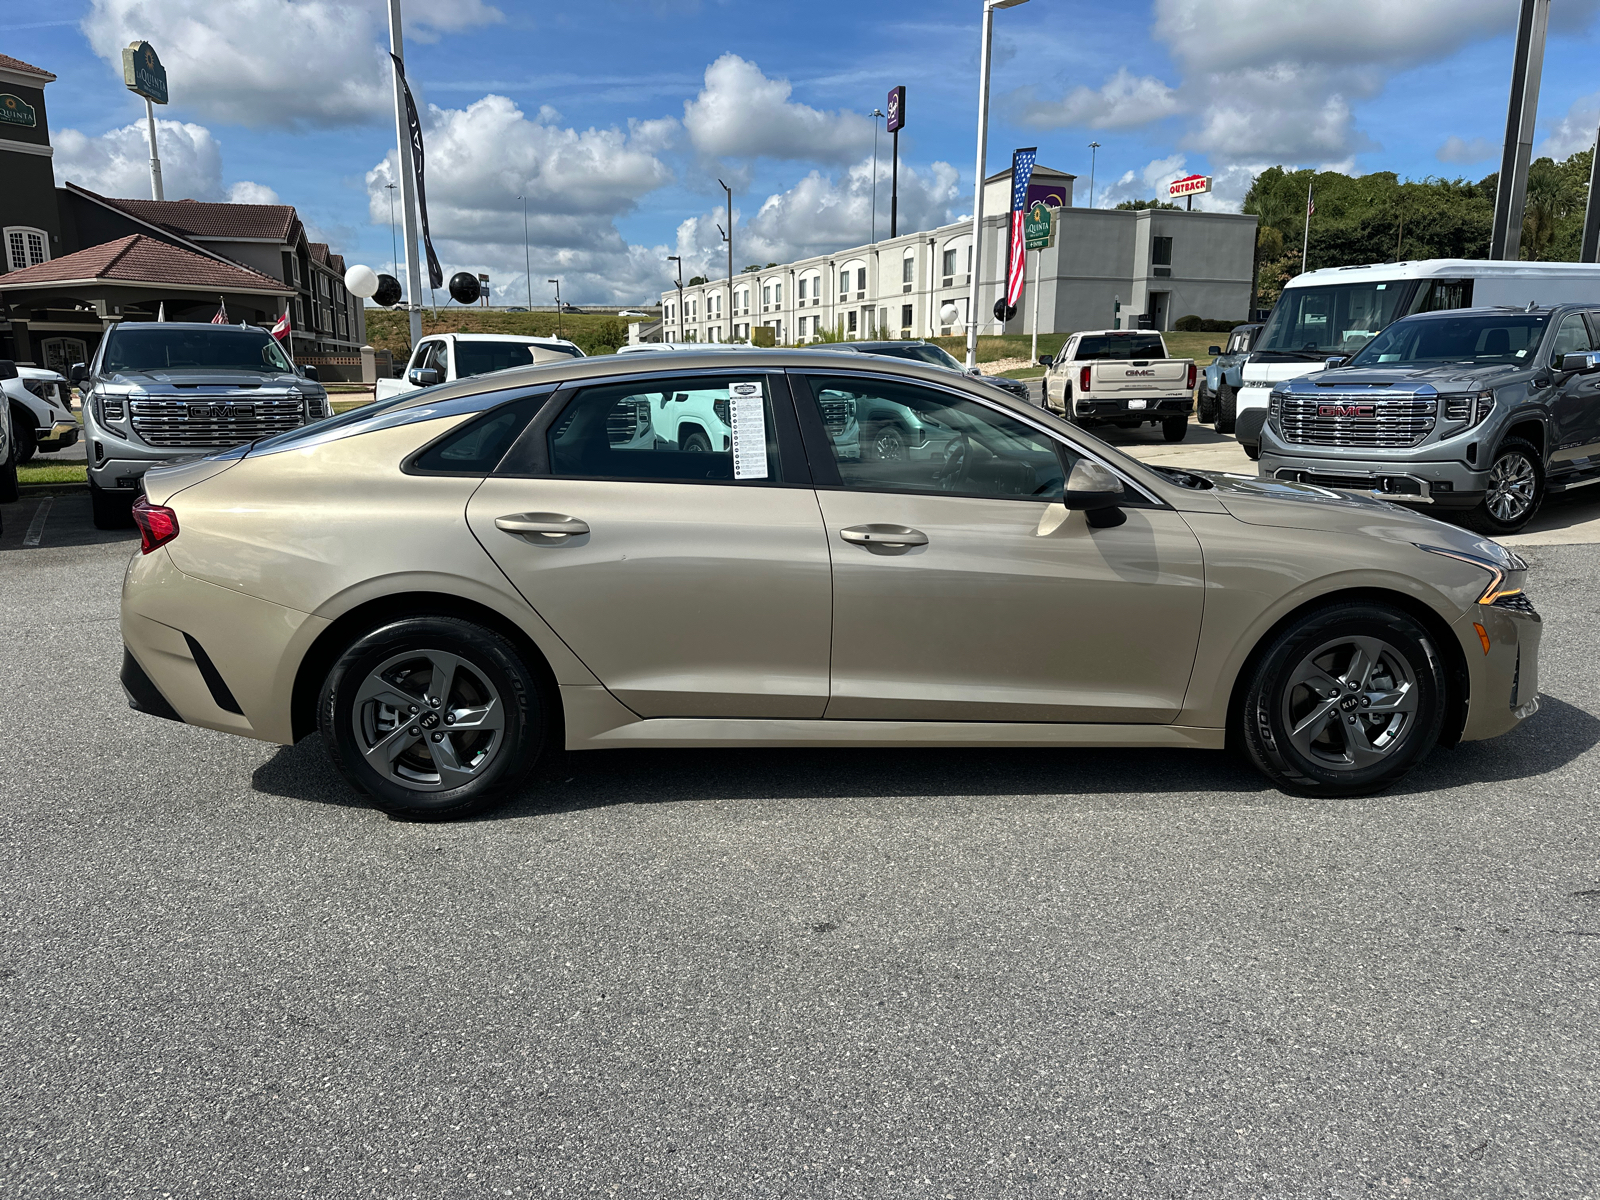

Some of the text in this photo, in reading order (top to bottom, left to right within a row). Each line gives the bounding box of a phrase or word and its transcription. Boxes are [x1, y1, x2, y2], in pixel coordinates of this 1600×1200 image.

[140, 68, 166, 93] QUINTA
[0, 108, 33, 121] QUINTA
[1169, 179, 1206, 195] OUTBACK
[1028, 222, 1049, 234] QUINTA
[190, 405, 253, 417] GMC
[1318, 405, 1374, 417] GMC
[1342, 698, 1358, 709] KIA
[421, 714, 438, 727] KIA
